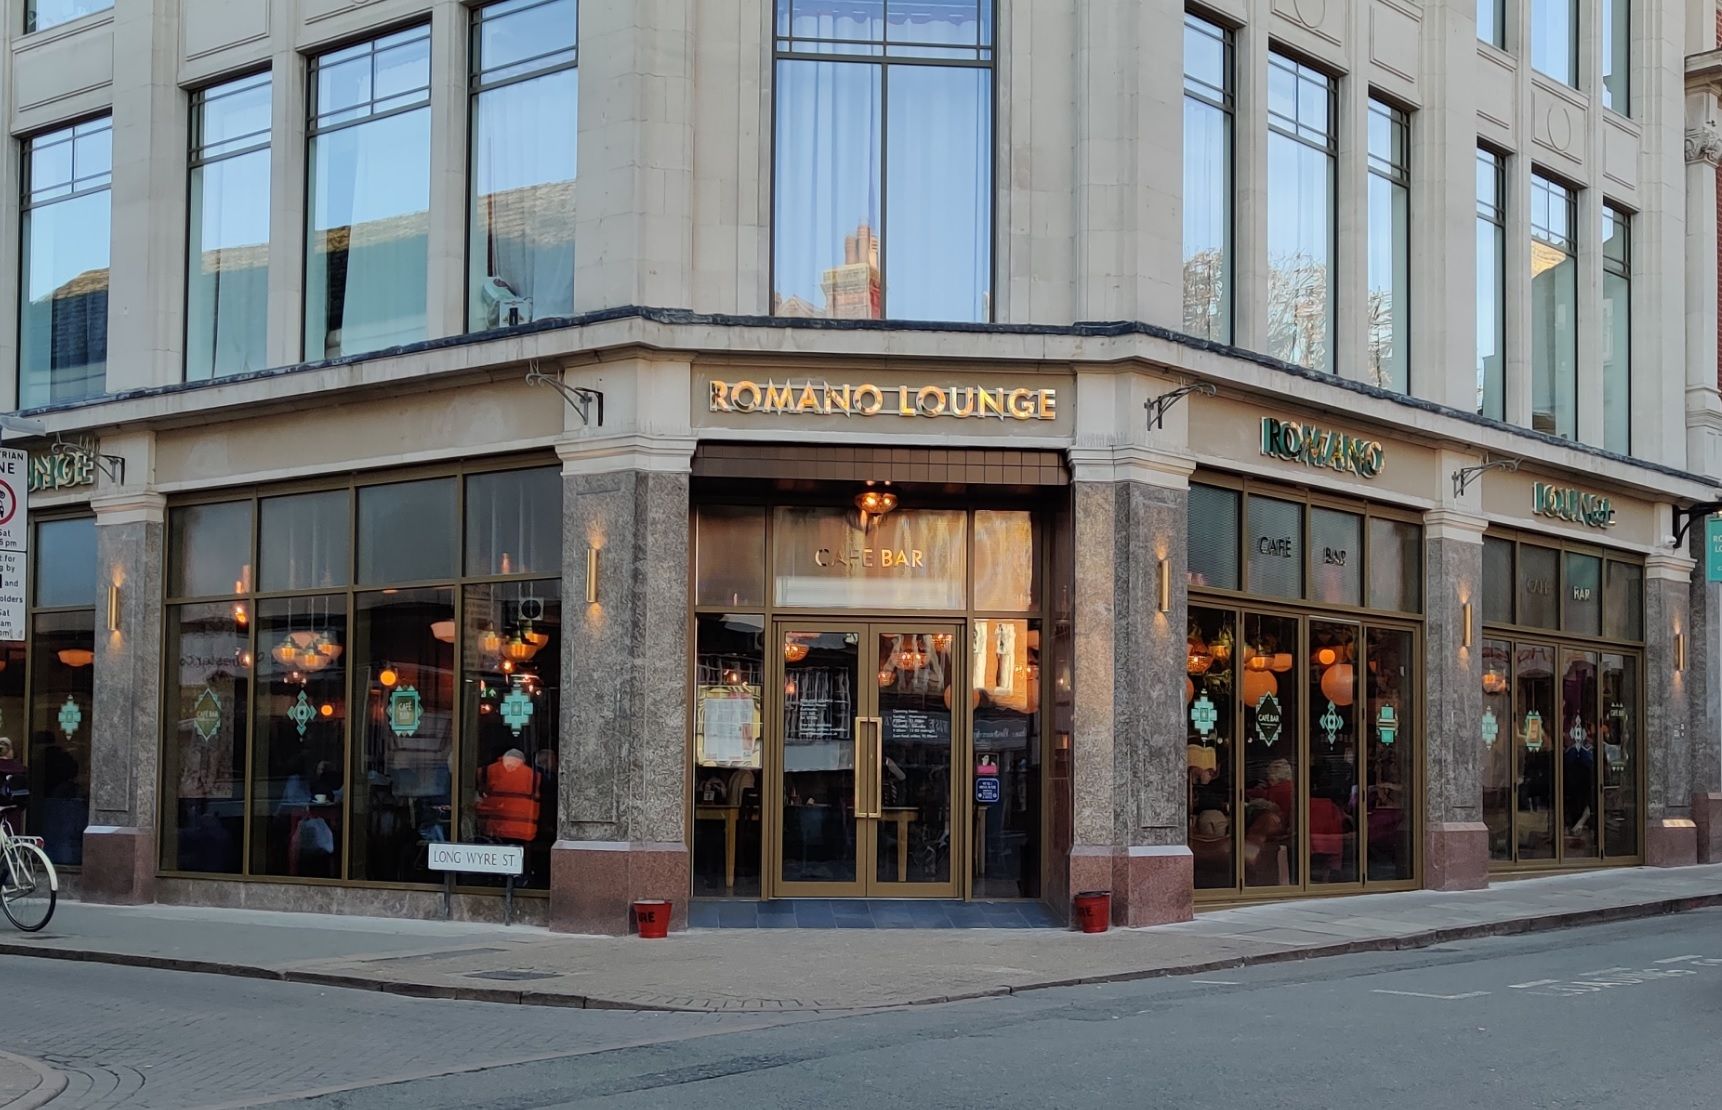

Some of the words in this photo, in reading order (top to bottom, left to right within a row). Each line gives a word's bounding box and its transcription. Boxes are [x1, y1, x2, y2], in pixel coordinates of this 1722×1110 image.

[709, 377, 884, 418] ROMANO
[898, 384, 1056, 422] LOUNGE
[0, 450, 24, 461] RIAN
[1260, 416, 1384, 479] ROMANO
[881, 549, 924, 568] BAR
[4, 579, 19, 588] and
[433, 850, 462, 864] LONG
[466, 852, 498, 866] WYRE
[502, 854, 516, 867] ST
